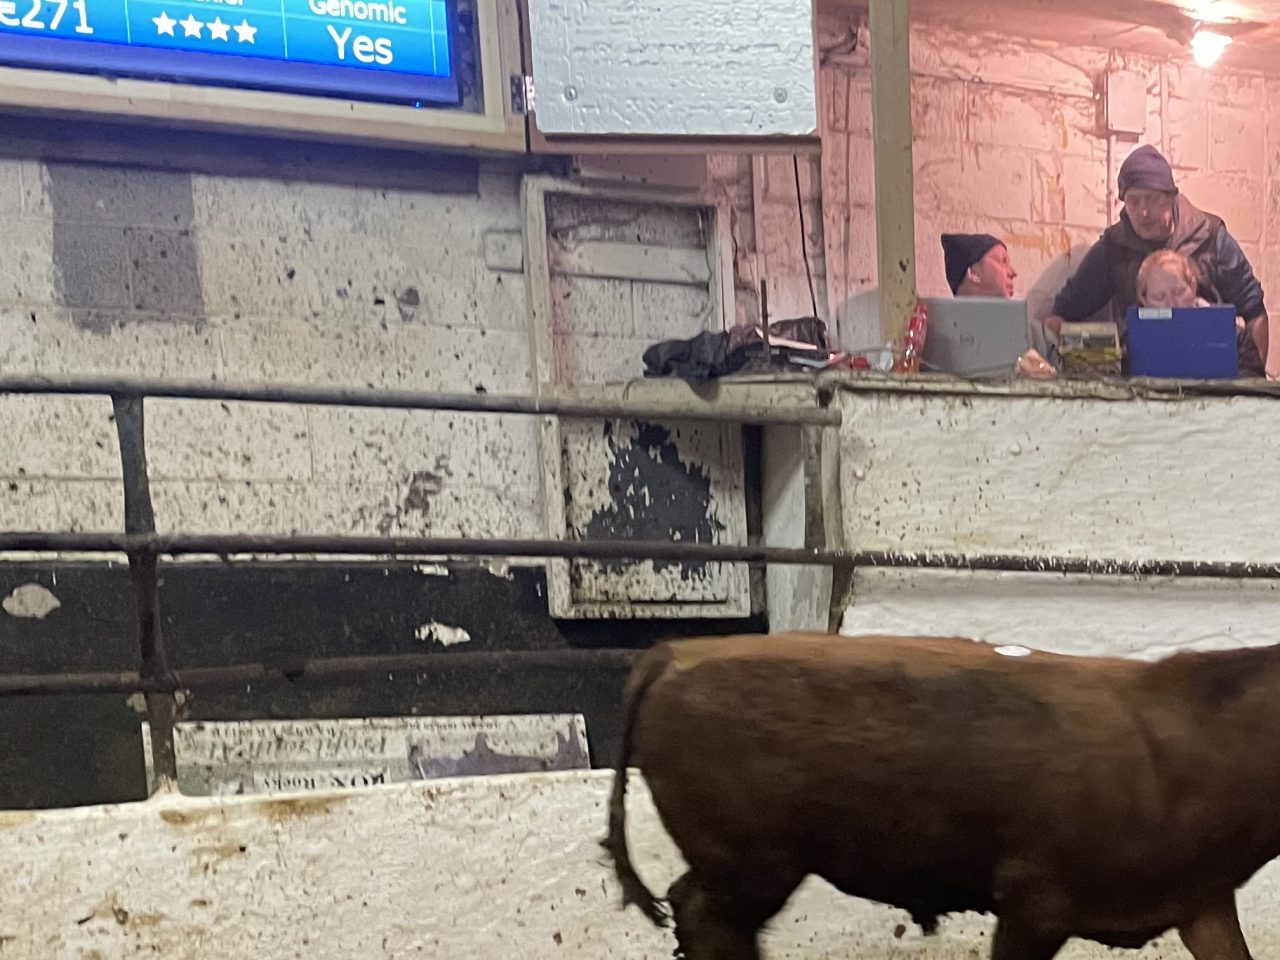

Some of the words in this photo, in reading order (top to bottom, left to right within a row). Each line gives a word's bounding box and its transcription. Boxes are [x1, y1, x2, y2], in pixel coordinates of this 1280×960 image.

[0, 0, 94, 34] €271
[309, 0, 407, 25] Genomic
[326, 24, 394, 65] Yes
